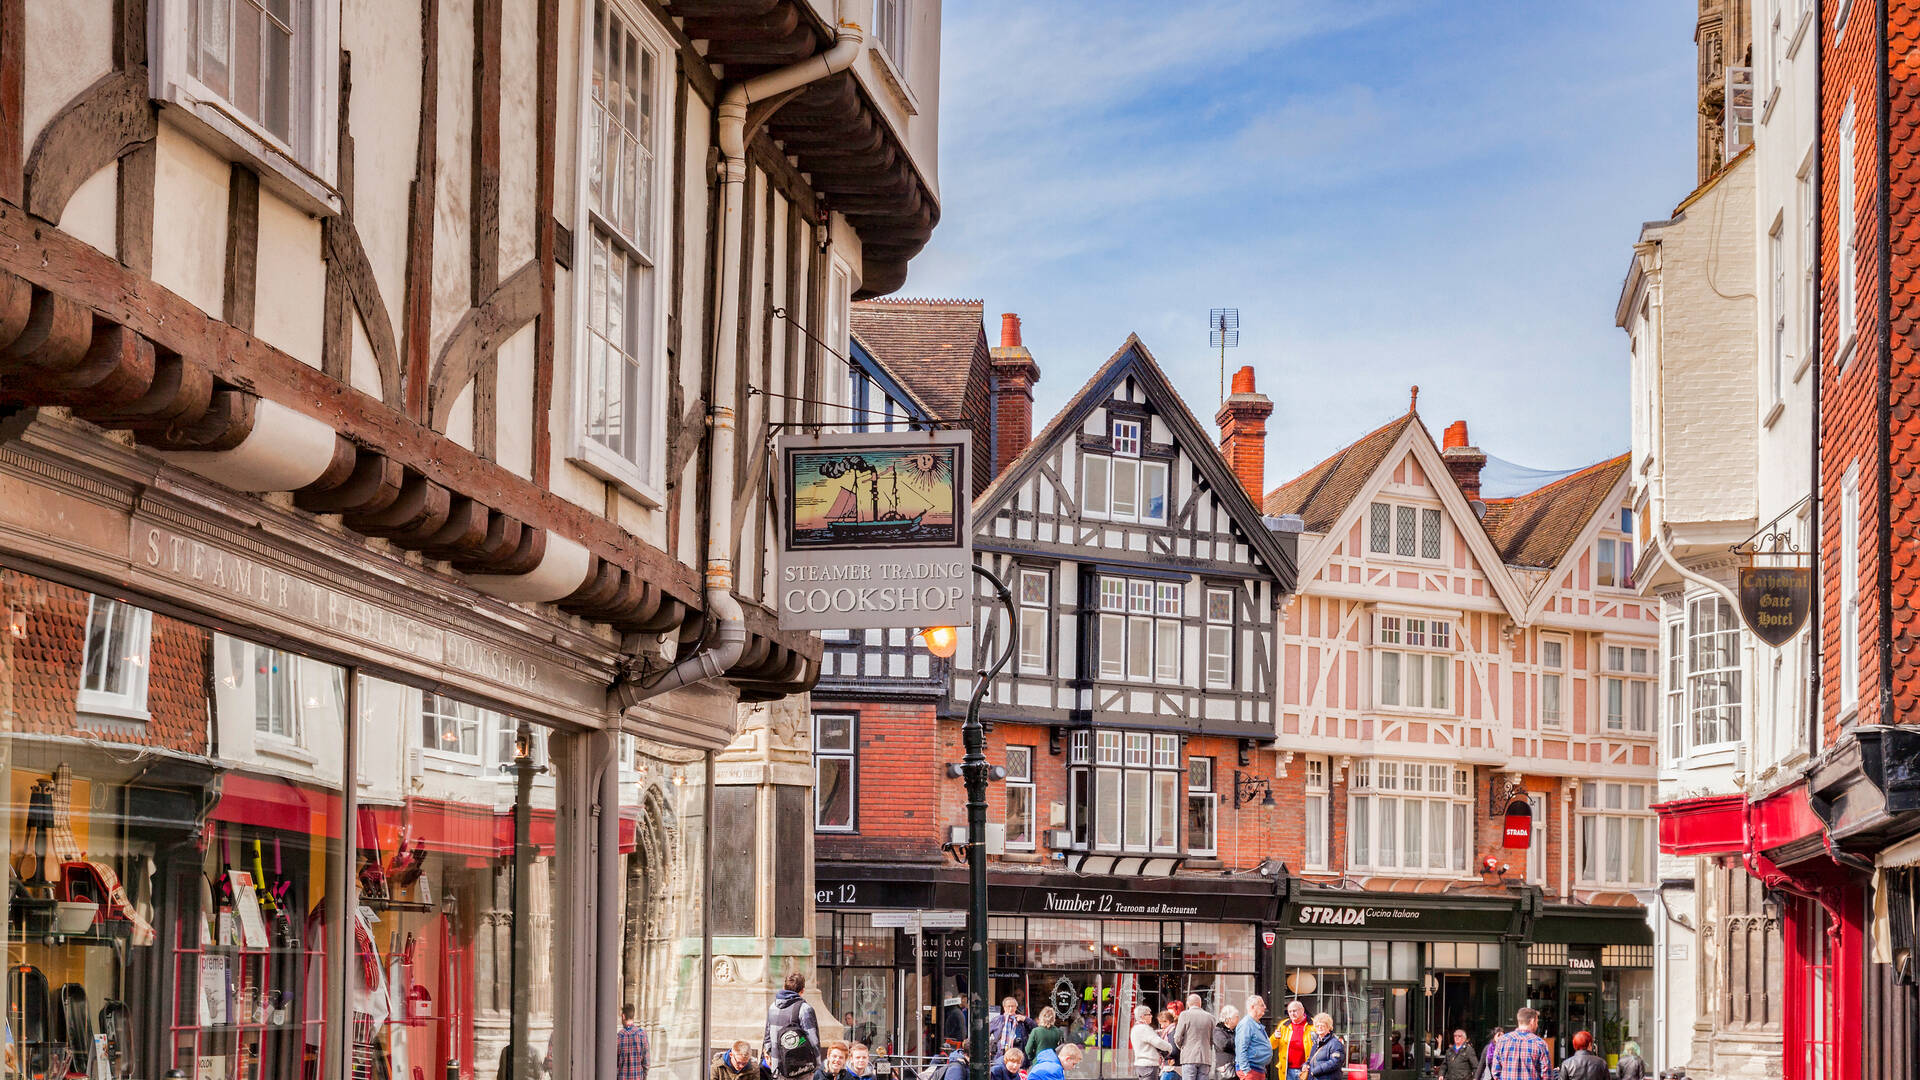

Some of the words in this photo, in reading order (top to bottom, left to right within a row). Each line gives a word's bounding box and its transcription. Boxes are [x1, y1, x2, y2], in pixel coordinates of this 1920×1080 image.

[784, 564, 872, 582] STEAMER
[879, 562, 965, 580] TRADING
[1743, 574, 1808, 590] Cathedral
[784, 586, 965, 614] COOKSHOP
[1759, 593, 1792, 608] Gate
[147, 528, 288, 608] STEAMER
[312, 588, 415, 651] TRADING
[433, 631, 537, 690] COOKSHOP
[1758, 611, 1793, 628] Hotel
[1506, 828, 1528, 836] STRADA
[814, 890, 834, 903] er
[838, 884, 856, 903] 12
[1043, 892, 1096, 912] Number
[1097, 894, 1113, 912] 12
[1115, 902, 1145, 913] Tearoom
[1146, 903, 1160, 914] and
[1161, 903, 1198, 915] Restaurant
[1298, 906, 1366, 926] STRADA
[1366, 907, 1391, 918] Cucina
[1392, 908, 1420, 919] Italiana
[909, 935, 927, 946] Te
[930, 938, 951, 946] tae
[954, 936, 965, 946] of
[912, 947, 962, 961] Cnteury
[1568, 958, 1595, 969] TRADA
